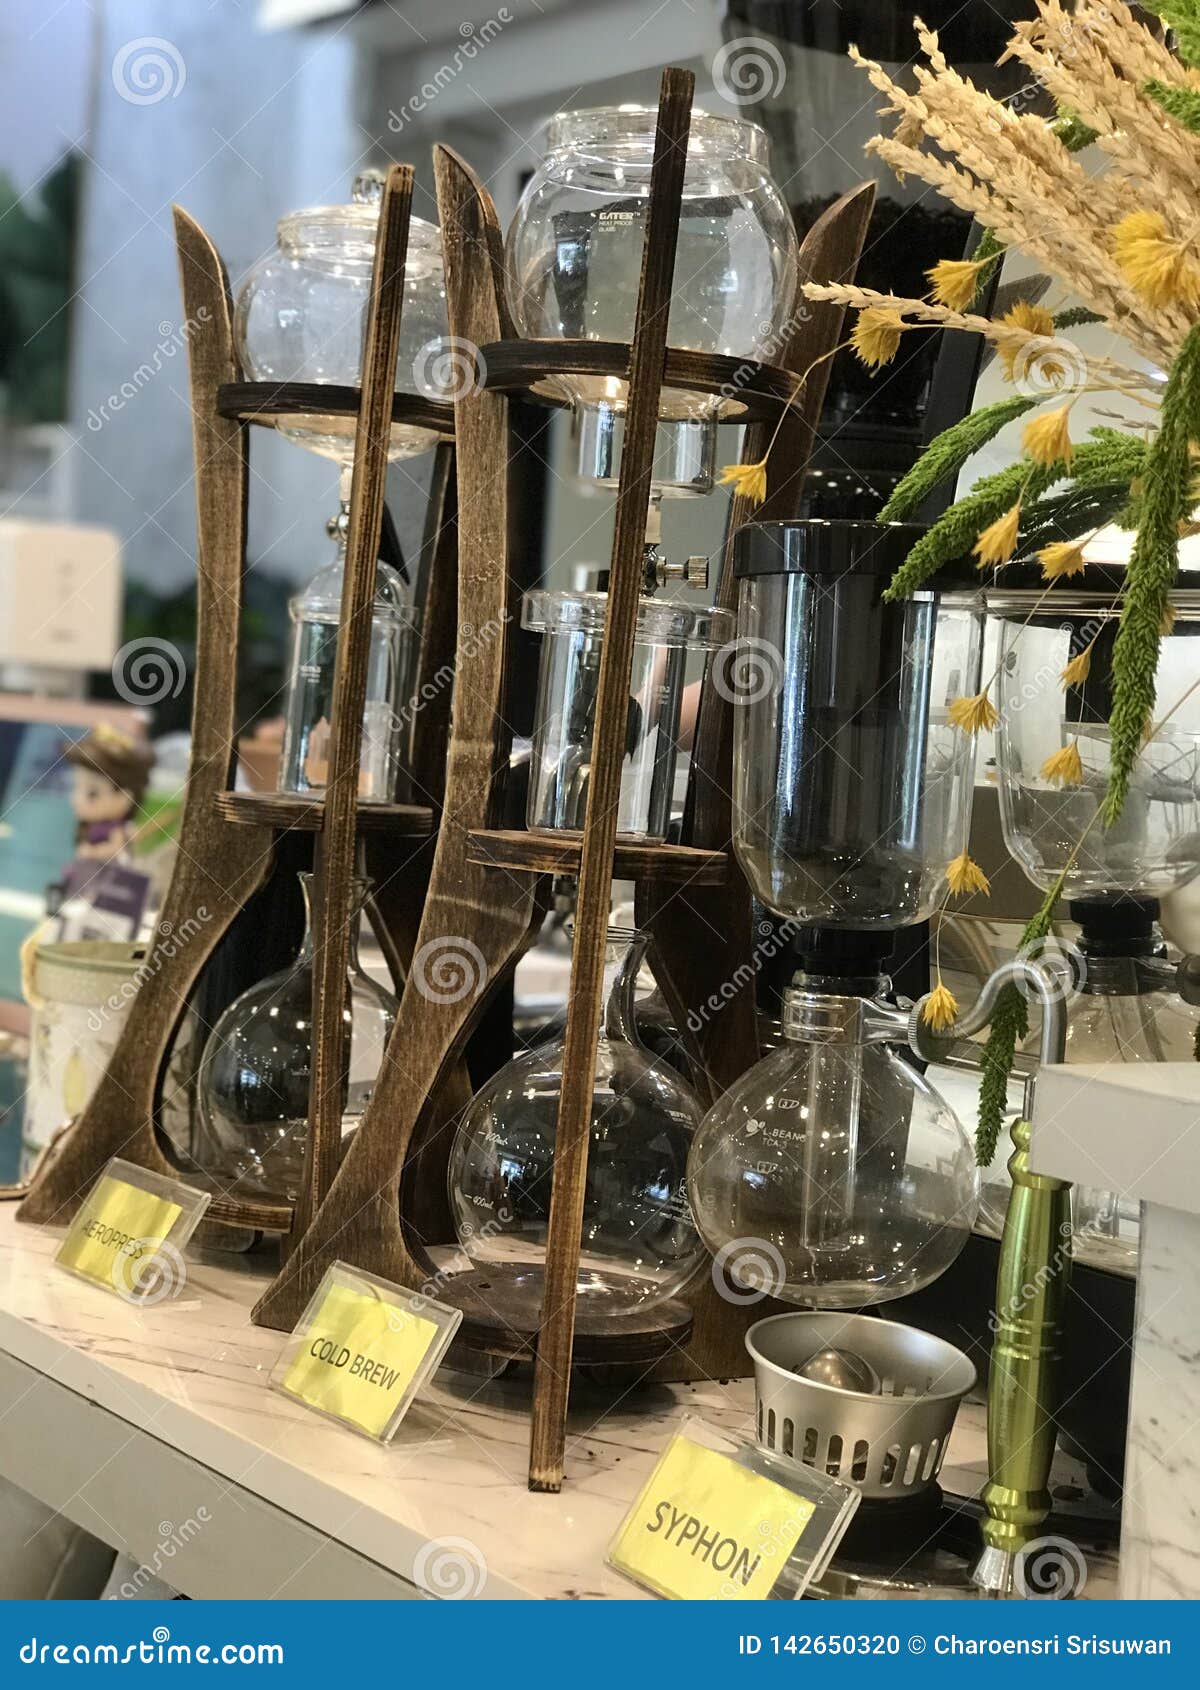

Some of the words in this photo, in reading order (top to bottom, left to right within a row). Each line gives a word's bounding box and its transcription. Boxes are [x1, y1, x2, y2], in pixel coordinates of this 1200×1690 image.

[83, 1218, 147, 1260] AEROPRESS
[310, 1337, 351, 1368] COLD
[348, 1353, 400, 1391] BREW
[646, 1501, 761, 1587] SYPHON
